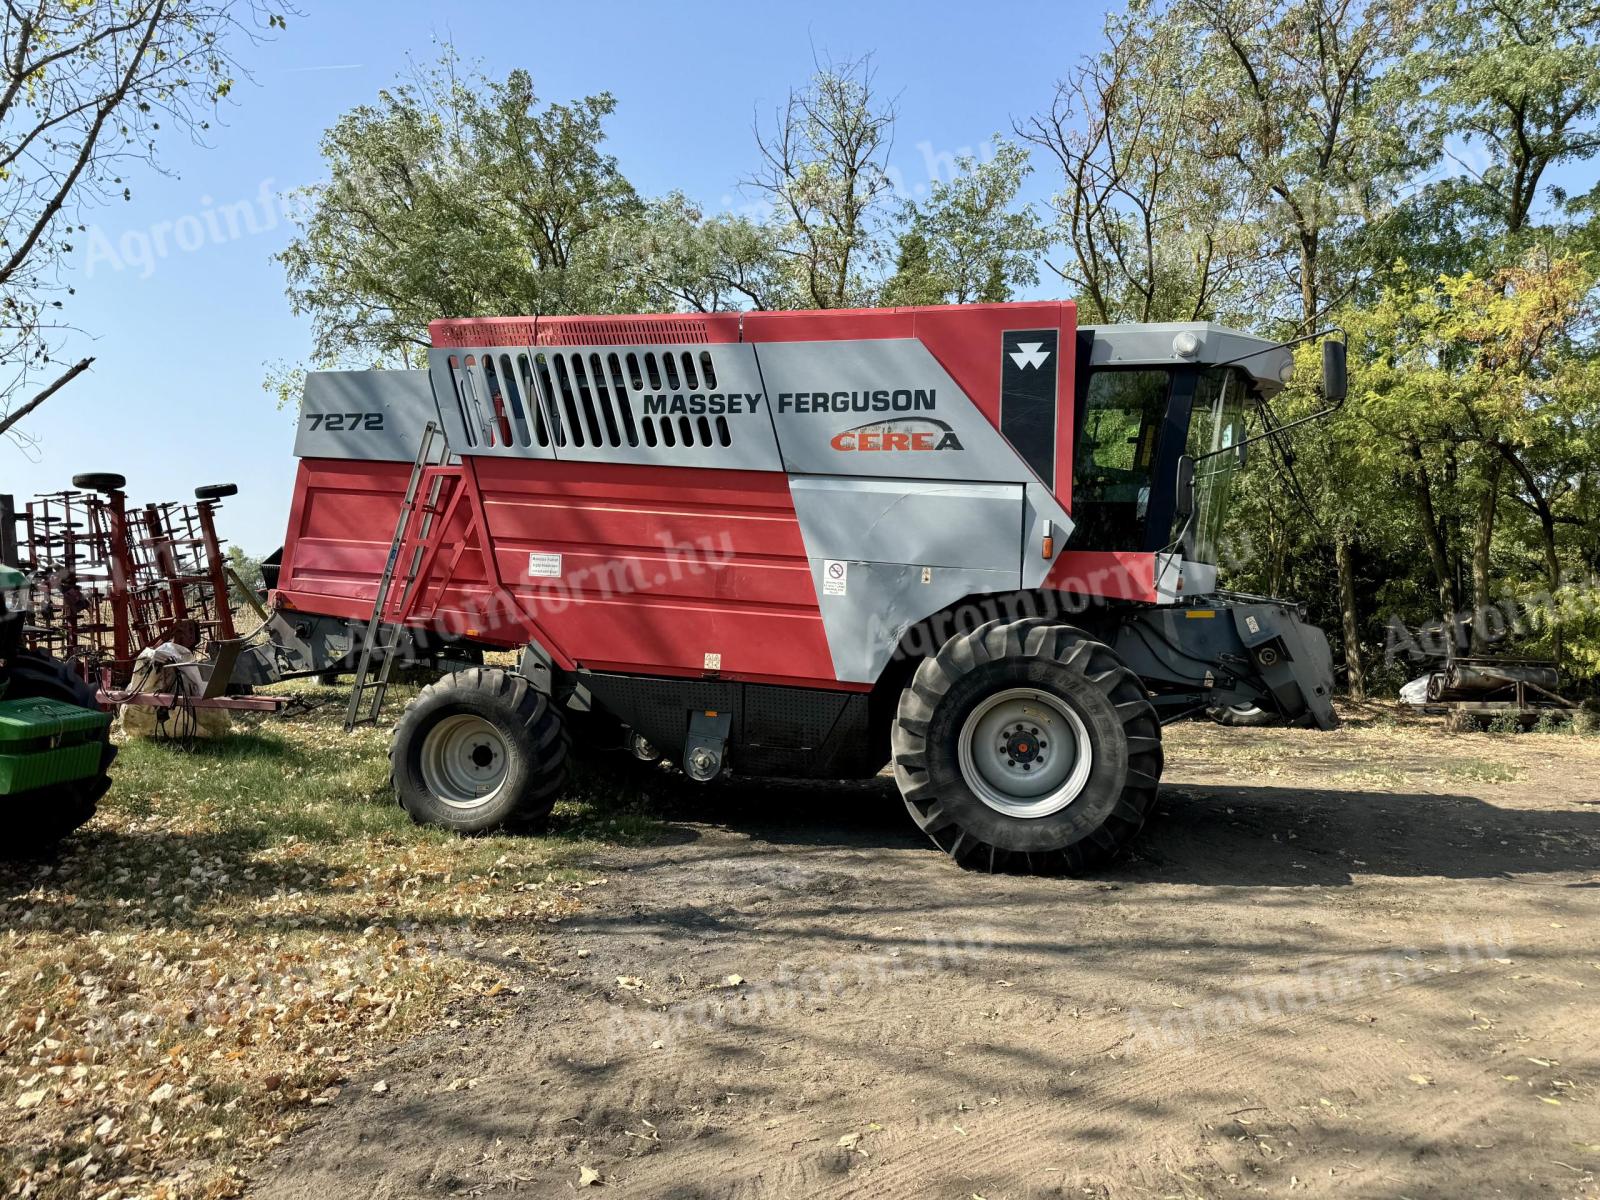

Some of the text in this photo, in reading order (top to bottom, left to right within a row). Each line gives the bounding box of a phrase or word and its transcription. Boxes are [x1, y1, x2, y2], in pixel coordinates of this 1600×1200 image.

[643, 389, 937, 415] MASSEY FERGUSON
[306, 413, 384, 431] 7272
[830, 432, 965, 452] CEREA
